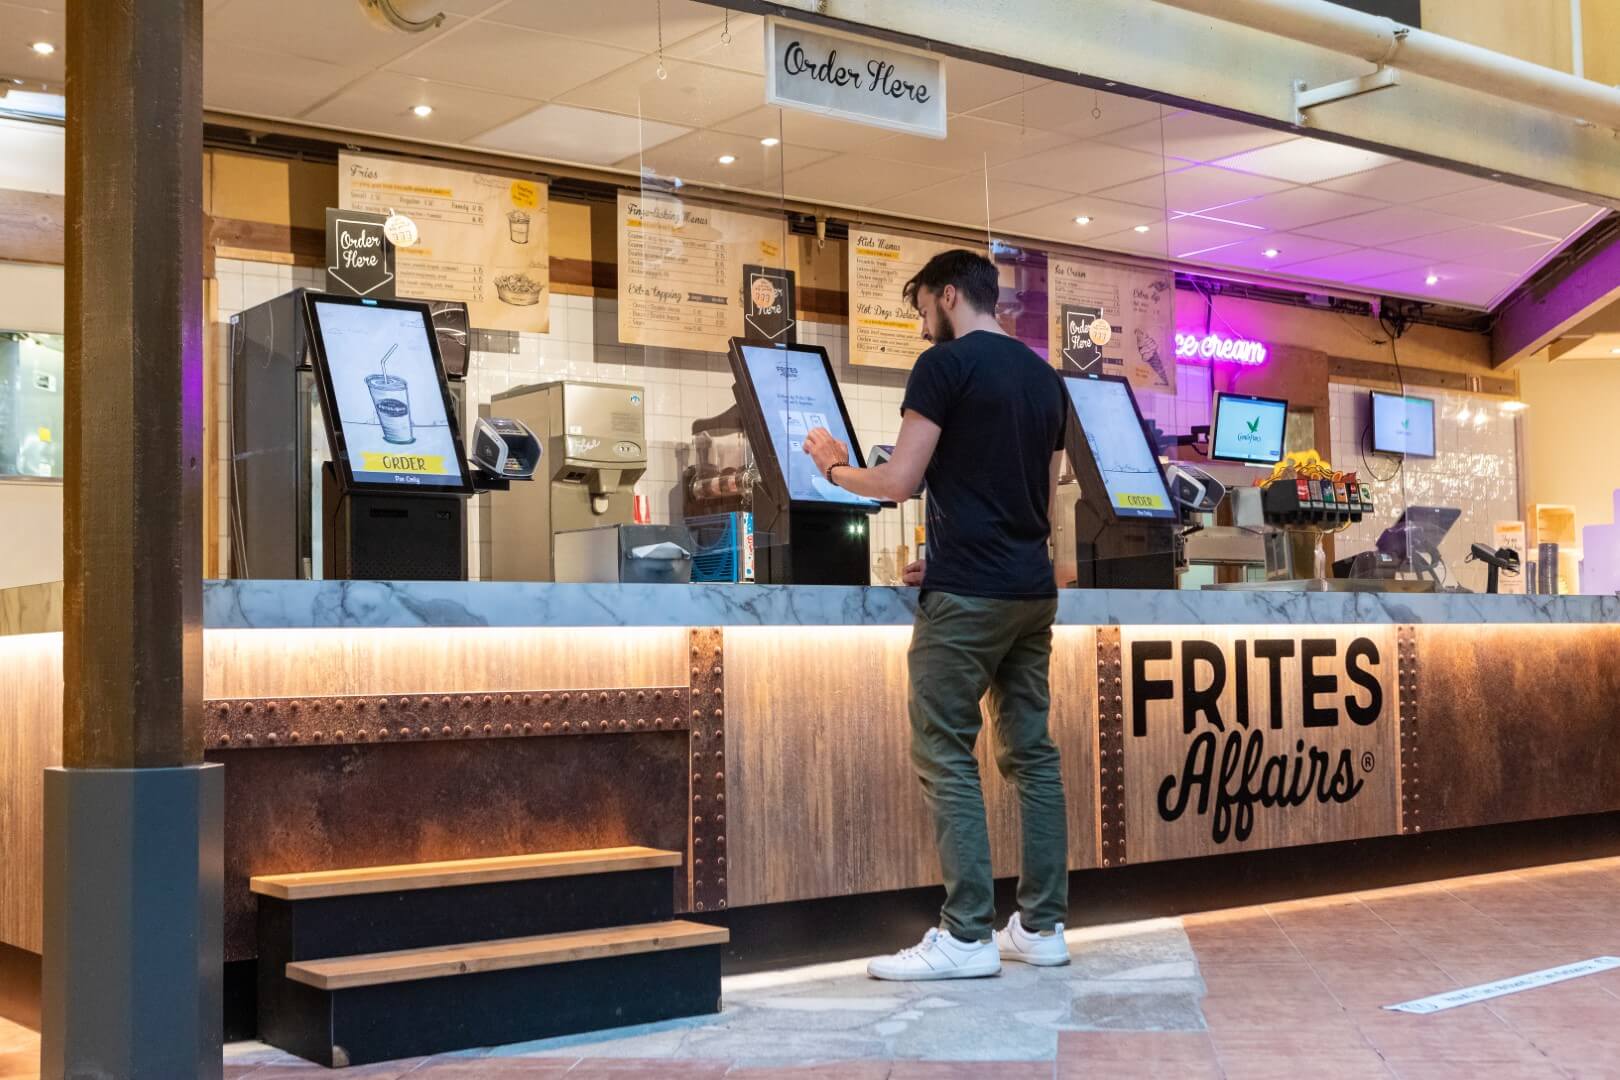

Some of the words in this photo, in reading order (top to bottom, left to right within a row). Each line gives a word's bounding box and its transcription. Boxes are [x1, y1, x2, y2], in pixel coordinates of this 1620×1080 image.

[784, 41, 862, 89] Order
[867, 59, 931, 103] Here
[350, 164, 378, 179] Fries
[340, 229, 381, 249] Order
[857, 236, 875, 248] Kids
[343, 250, 379, 268] Here
[1071, 335, 1093, 349] Here
[383, 455, 427, 471] ORDER
[1127, 495, 1153, 506] ORDER
[1131, 637, 1383, 737] FRITES
